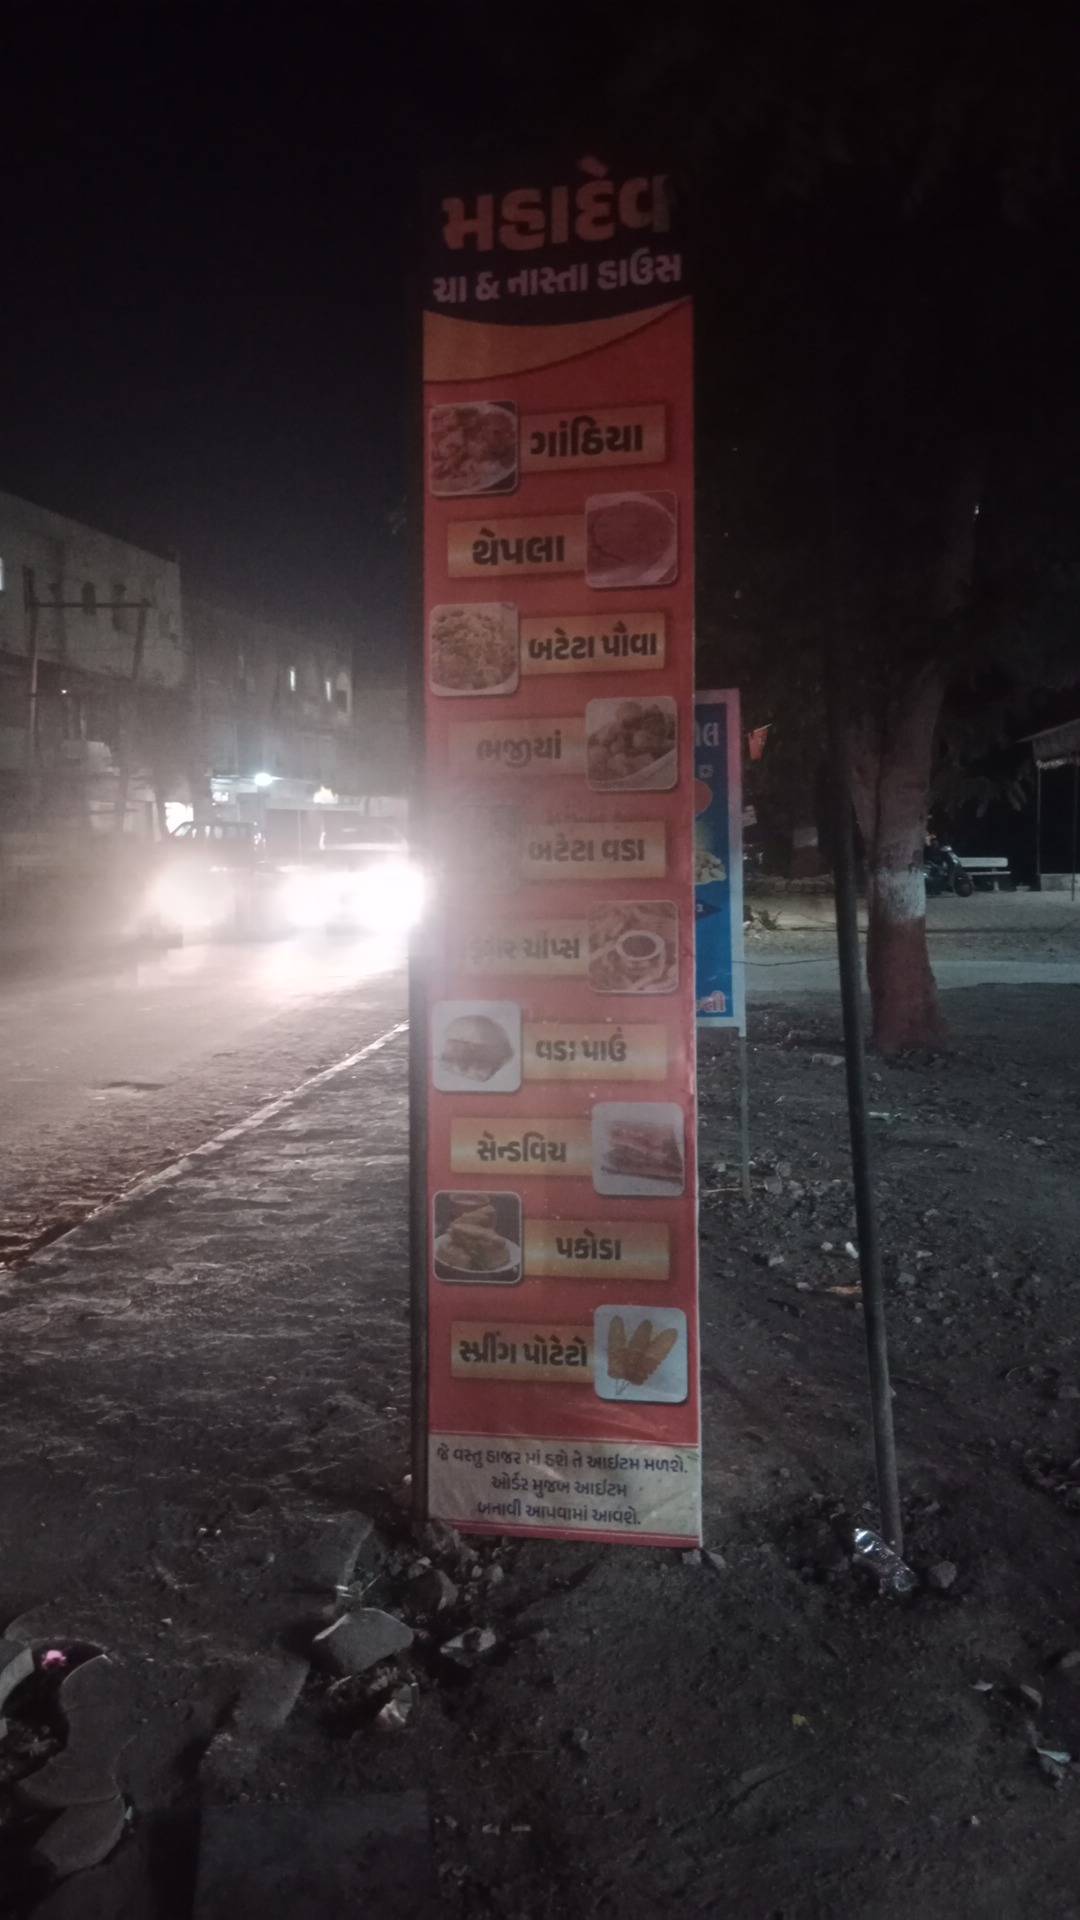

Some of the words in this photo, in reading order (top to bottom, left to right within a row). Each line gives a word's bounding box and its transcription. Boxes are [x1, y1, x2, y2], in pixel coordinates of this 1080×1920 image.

[433, 275, 468, 304] ચા
[475, 271, 501, 301] &
[507, 263, 588, 296] નાસ્તા
[597, 247, 683, 290] હાઉસ
[531, 416, 643, 457] ગાંઠિયા
[472, 528, 566, 566] થેપલા
[529, 627, 595, 660] બટેટા
[529, 832, 594, 862] બટેટા
[602, 838, 645, 862] વડા
[535, 1040, 575, 1062] વડા
[583, 1026, 627, 1063] પાઉં
[477, 1130, 567, 1163] સેન્ડવિચ
[556, 1228, 622, 1261] પકોડા
[522, 1334, 588, 1367] પોટેટો
[437, 1443, 450, 1461] જે
[453, 1448, 484, 1469] વસ્તુ
[545, 1450, 570, 1468] હશે
[573, 1450, 582, 1469] તે
[532, 1479, 570, 1499] મુજબ
[477, 1499, 522, 1518] બનાવી
[525, 1504, 588, 1523] આપવામાં
